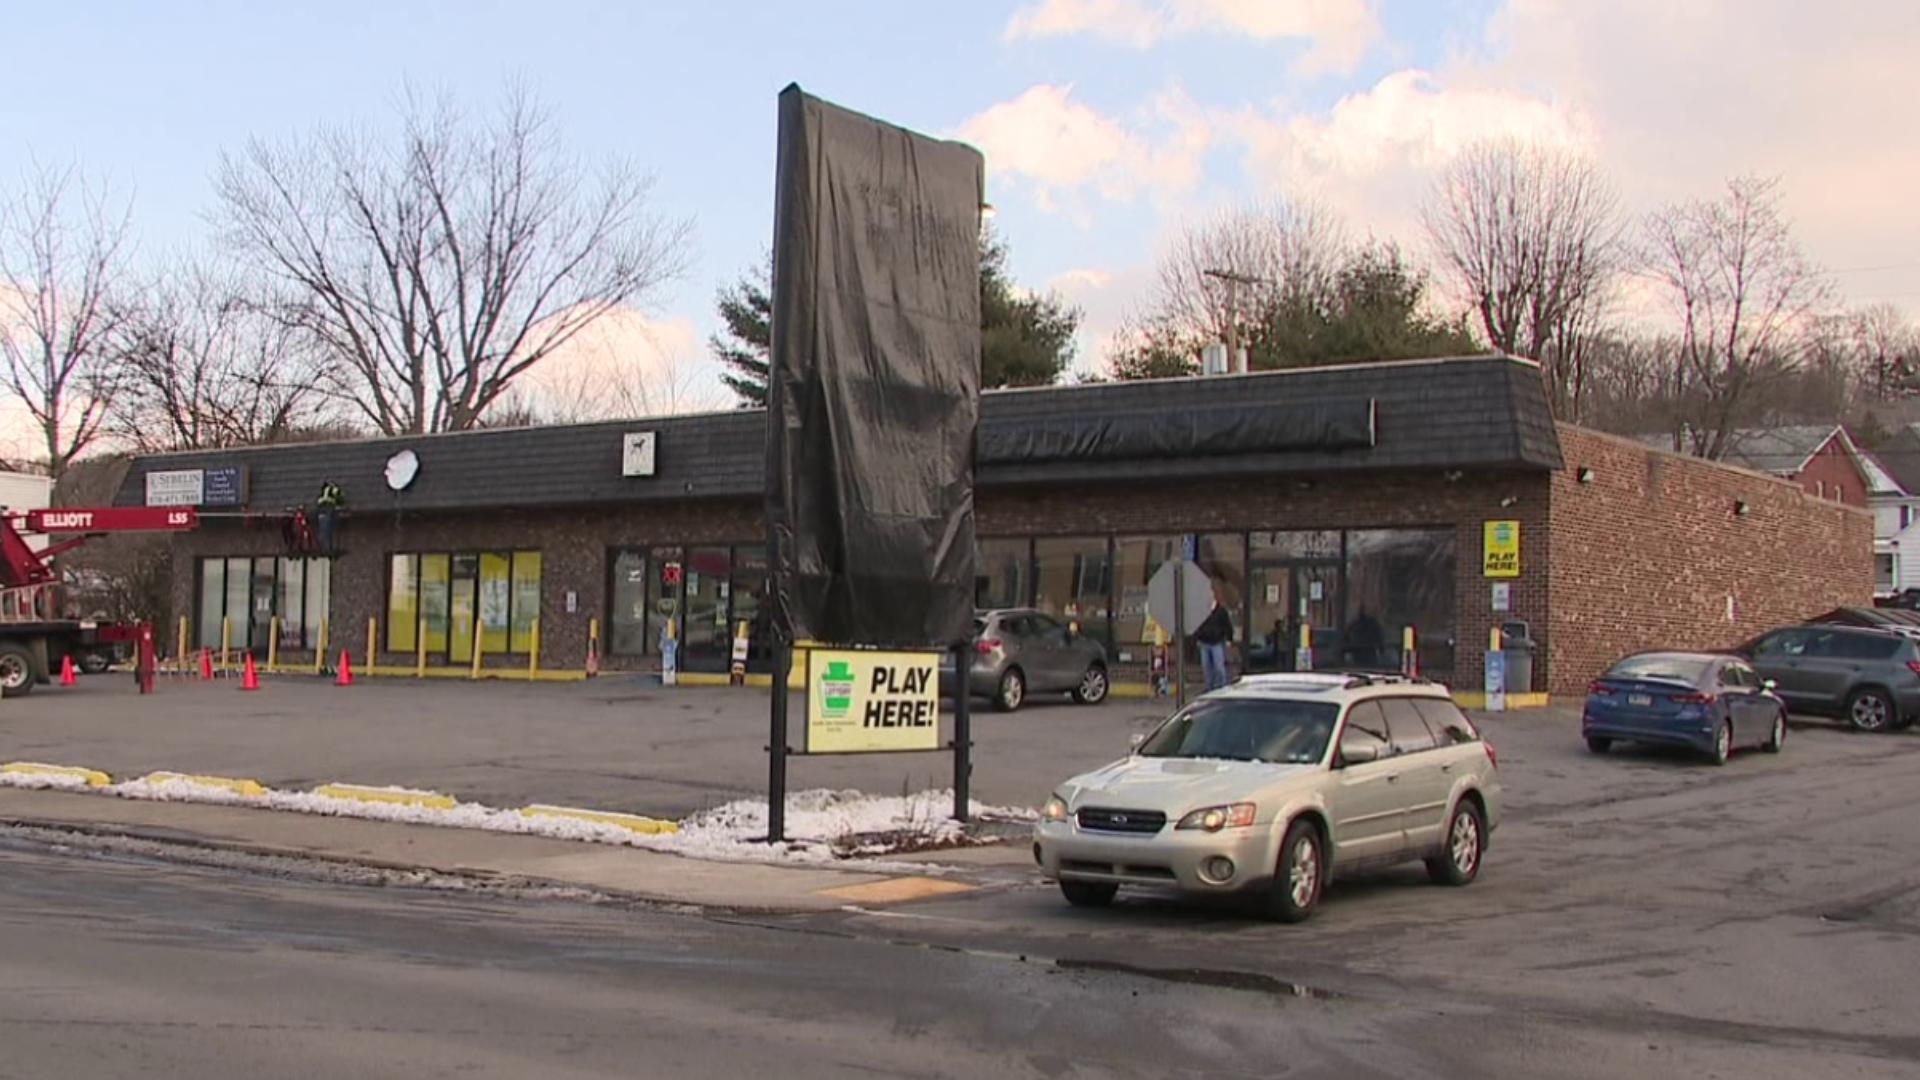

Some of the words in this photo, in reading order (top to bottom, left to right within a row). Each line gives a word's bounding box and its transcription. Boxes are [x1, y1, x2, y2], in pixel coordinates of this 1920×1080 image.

[43, 512, 93, 527] ELLIOTT
[1489, 552, 1515, 561] PLAY
[1486, 562, 1517, 571] HERE!
[870, 666, 932, 694] PLAY
[863, 700, 935, 728] HERE!
